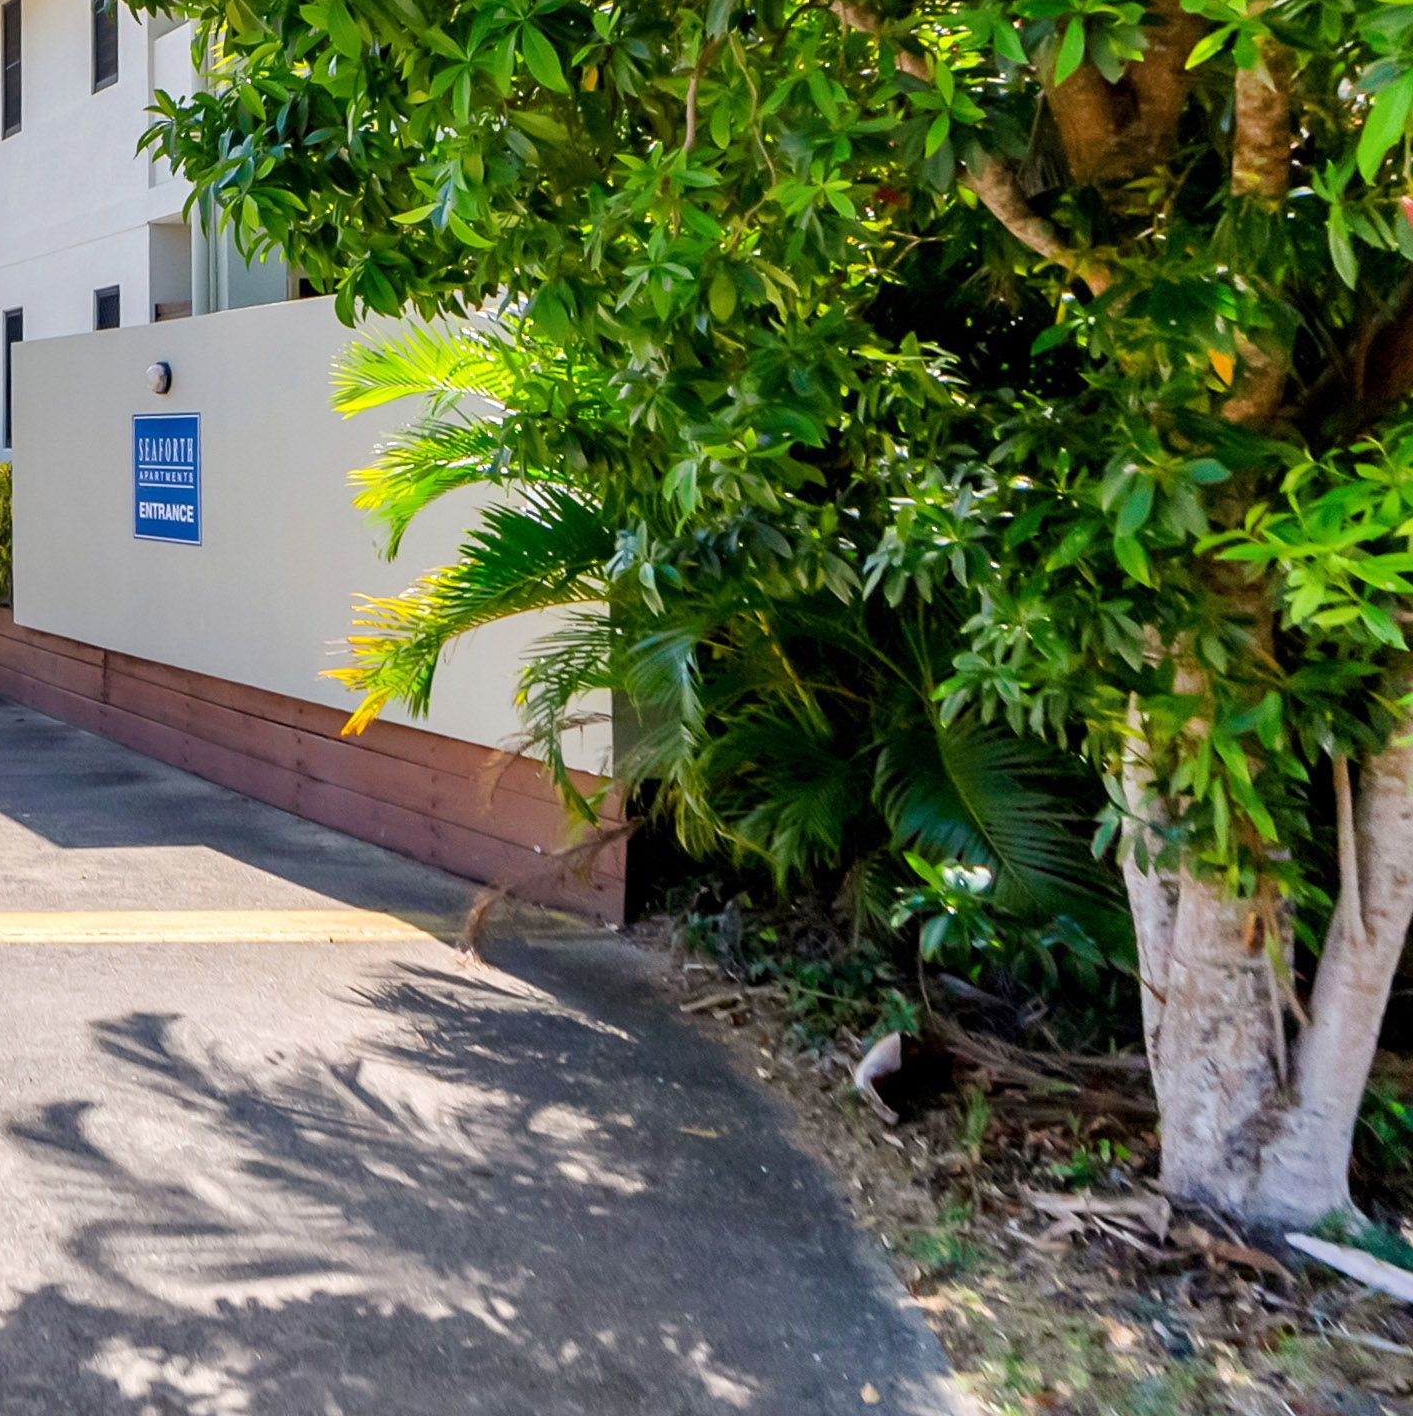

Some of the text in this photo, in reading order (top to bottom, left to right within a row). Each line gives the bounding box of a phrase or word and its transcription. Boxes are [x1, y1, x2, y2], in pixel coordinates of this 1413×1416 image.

[138, 437, 194, 463] SEAFORTH
[138, 470, 194, 483] APARTMENTS
[139, 501, 195, 523] ENTRANCE
